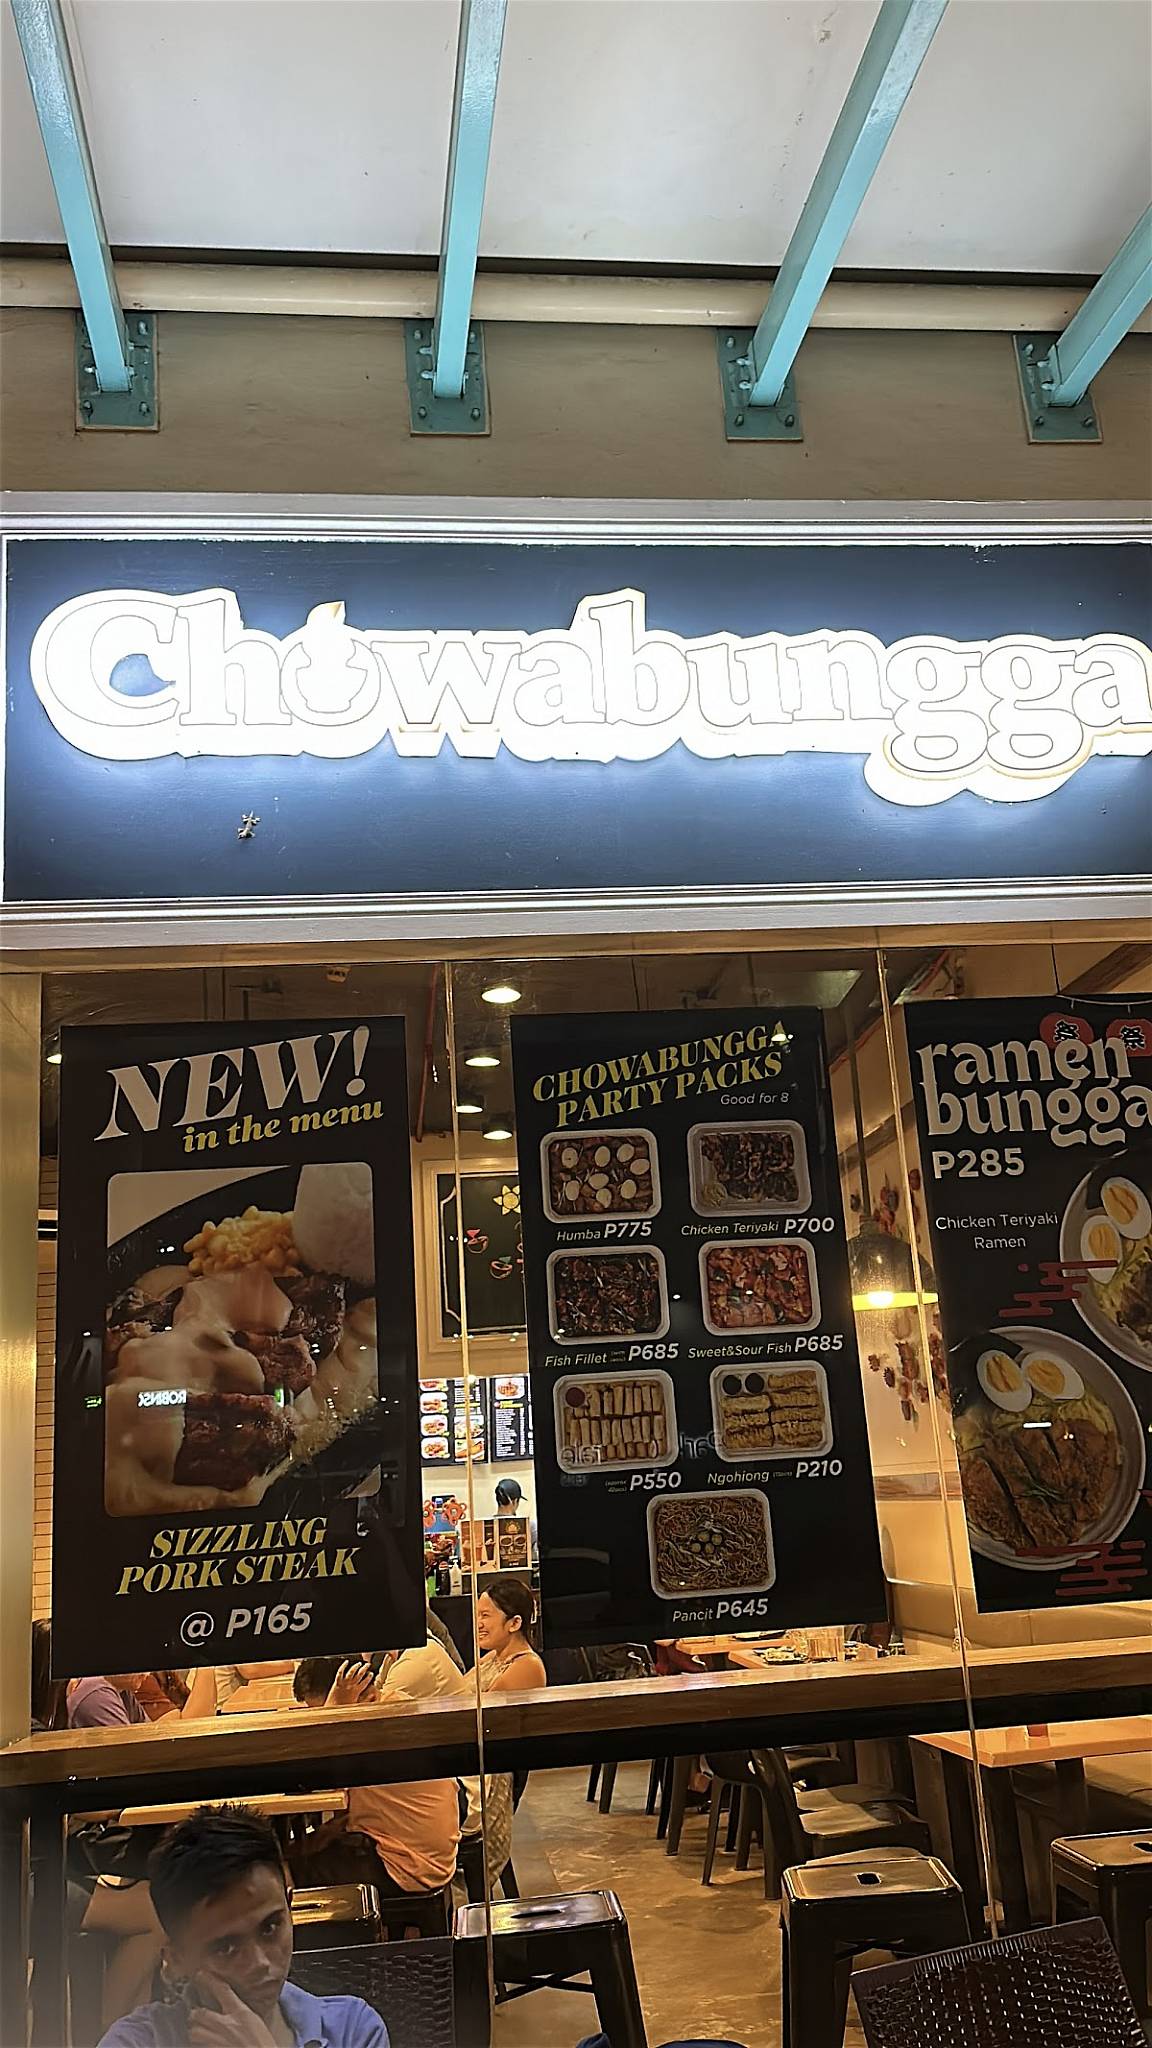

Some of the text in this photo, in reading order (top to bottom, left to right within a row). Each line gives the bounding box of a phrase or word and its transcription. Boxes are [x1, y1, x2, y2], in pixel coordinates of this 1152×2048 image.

[38, 592, 1152, 790] Chowabungga
[532, 1020, 790, 1102] CHOWABUNGGA
[916, 1038, 1132, 1086] ramen
[94, 1025, 370, 1141] NEW!
[555, 1051, 784, 1128] PARTY PACKS
[720, 1092, 789, 1105] Good for 8
[182, 1100, 384, 1153] in the menu
[920, 1078, 1152, 1147] bungga
[932, 1148, 1025, 1179] P285
[556, 1221, 652, 1242] Humba P775
[681, 1217, 835, 1236] Chicken Teriyaki P700
[935, 1212, 1058, 1230] Chicken Teriyaki
[974, 1235, 1026, 1249] Ramen
[545, 1354, 572, 1367] Fish
[575, 1352, 607, 1366] Fillet
[628, 1342, 679, 1361] P685
[687, 1335, 844, 1359] Sweet&Sour Fish P685
[629, 1471, 682, 1491] P550
[707, 1470, 770, 1485] Ngohiong
[795, 1459, 843, 1478] P210
[150, 1517, 327, 1560] SIZZLING
[115, 1547, 361, 1596] PORK STEAK
[180, 1602, 313, 1646] @ P165
[672, 1598, 768, 1623] Pancit P645
